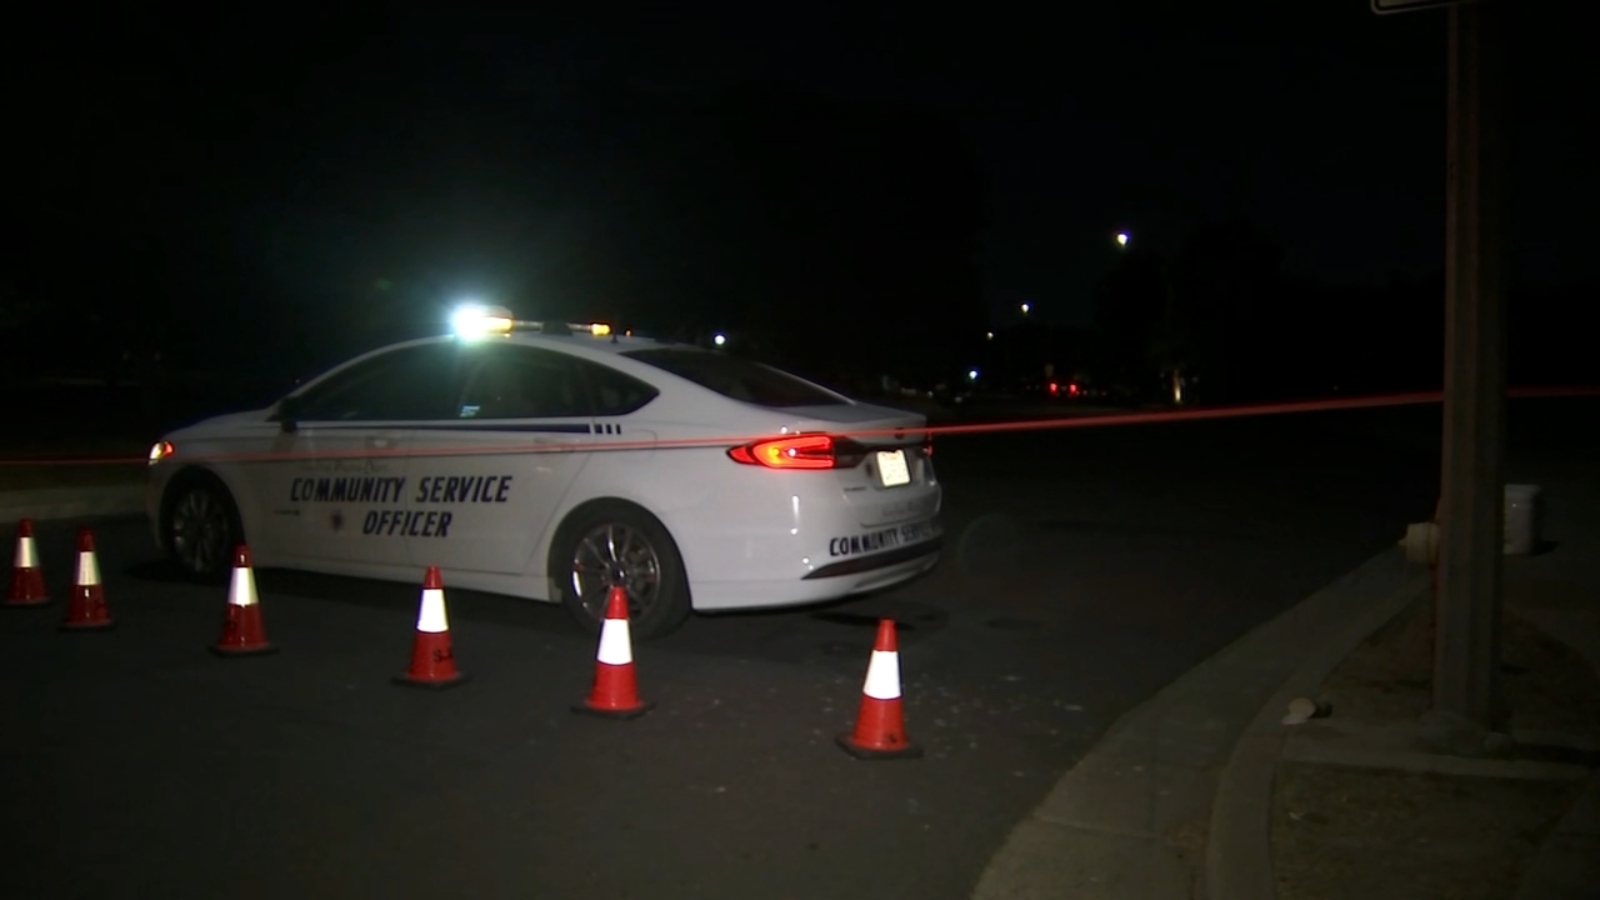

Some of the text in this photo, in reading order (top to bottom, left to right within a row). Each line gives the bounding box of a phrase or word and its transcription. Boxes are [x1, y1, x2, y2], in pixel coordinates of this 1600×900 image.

[290, 475, 512, 502] COMMUNITY SERVICE
[362, 510, 452, 537] OFFICER
